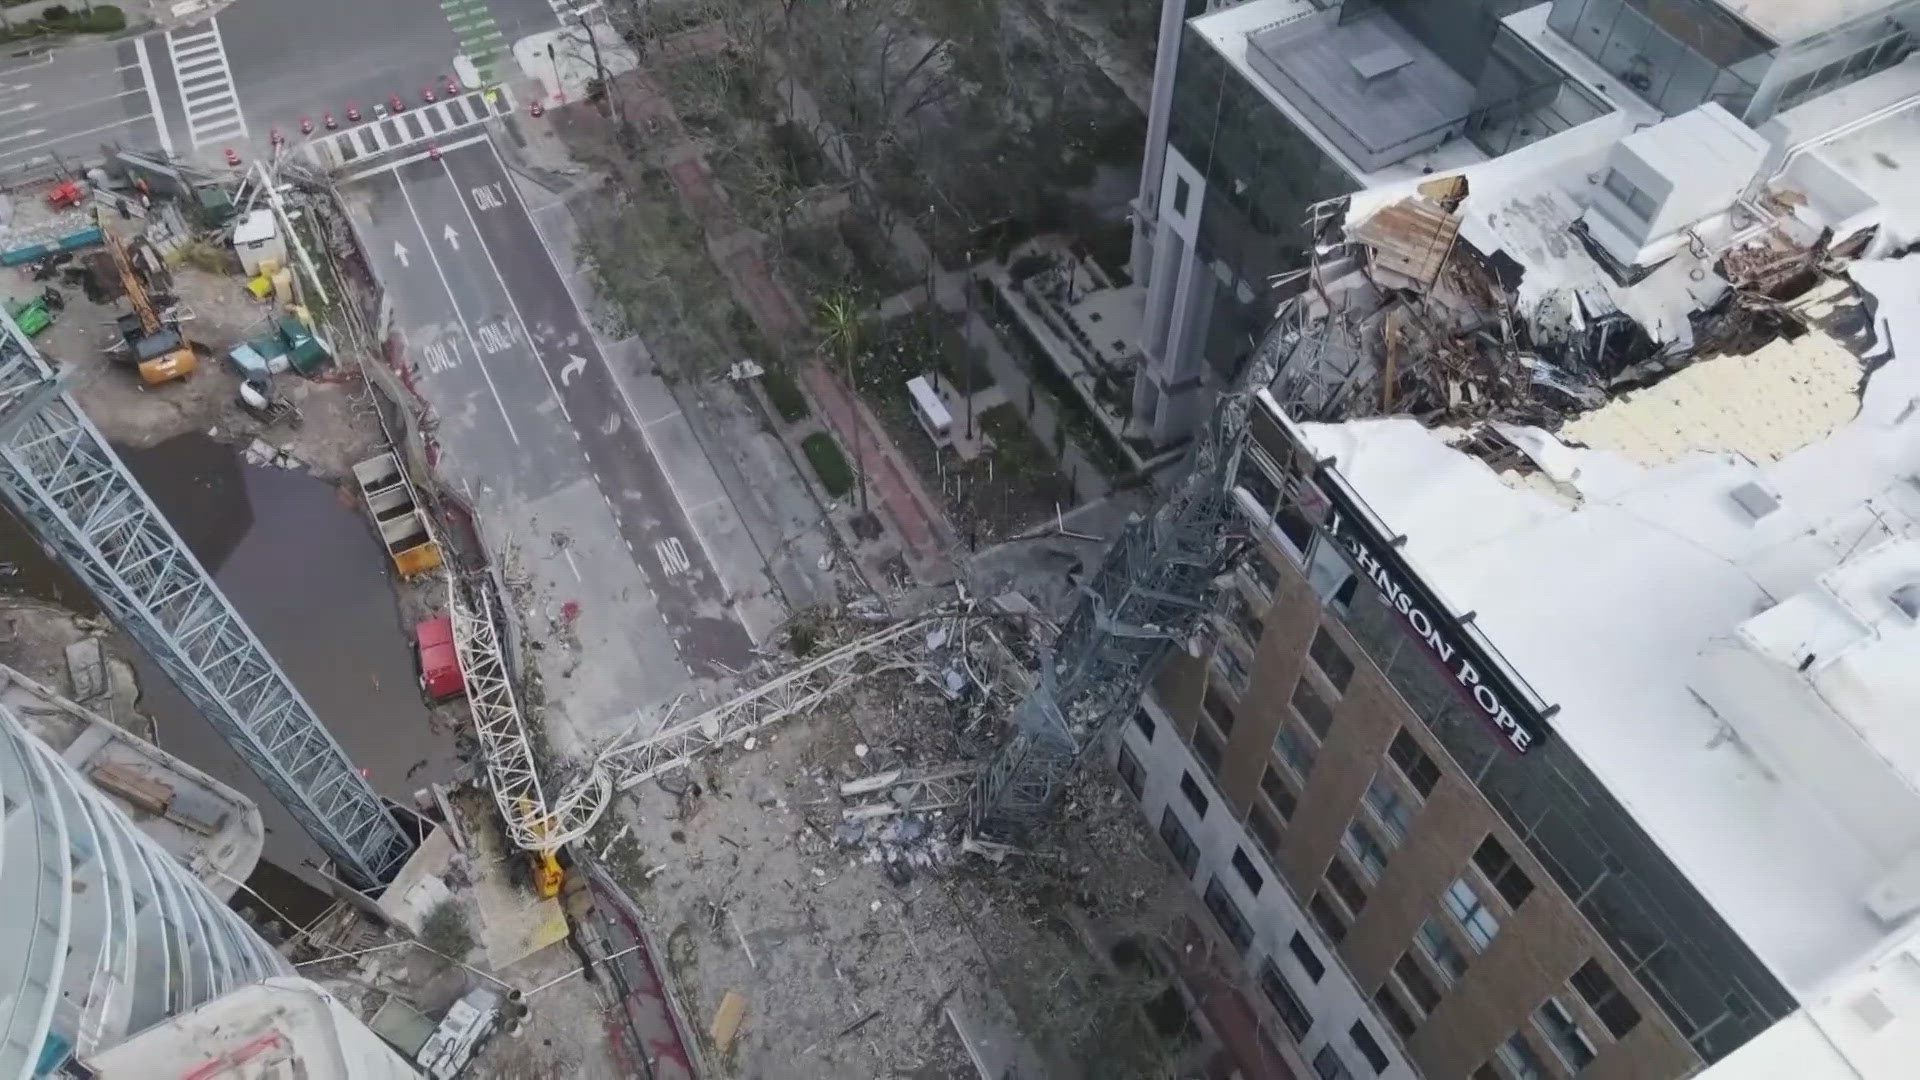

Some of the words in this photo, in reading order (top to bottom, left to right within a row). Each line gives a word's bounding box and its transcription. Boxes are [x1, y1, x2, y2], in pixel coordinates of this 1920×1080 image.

[472, 181, 507, 210] ONLY
[479, 318, 518, 353] ONLY
[423, 336, 463, 373] ONLY
[655, 536, 691, 578] AND
[1456, 659, 1532, 753] POPE
